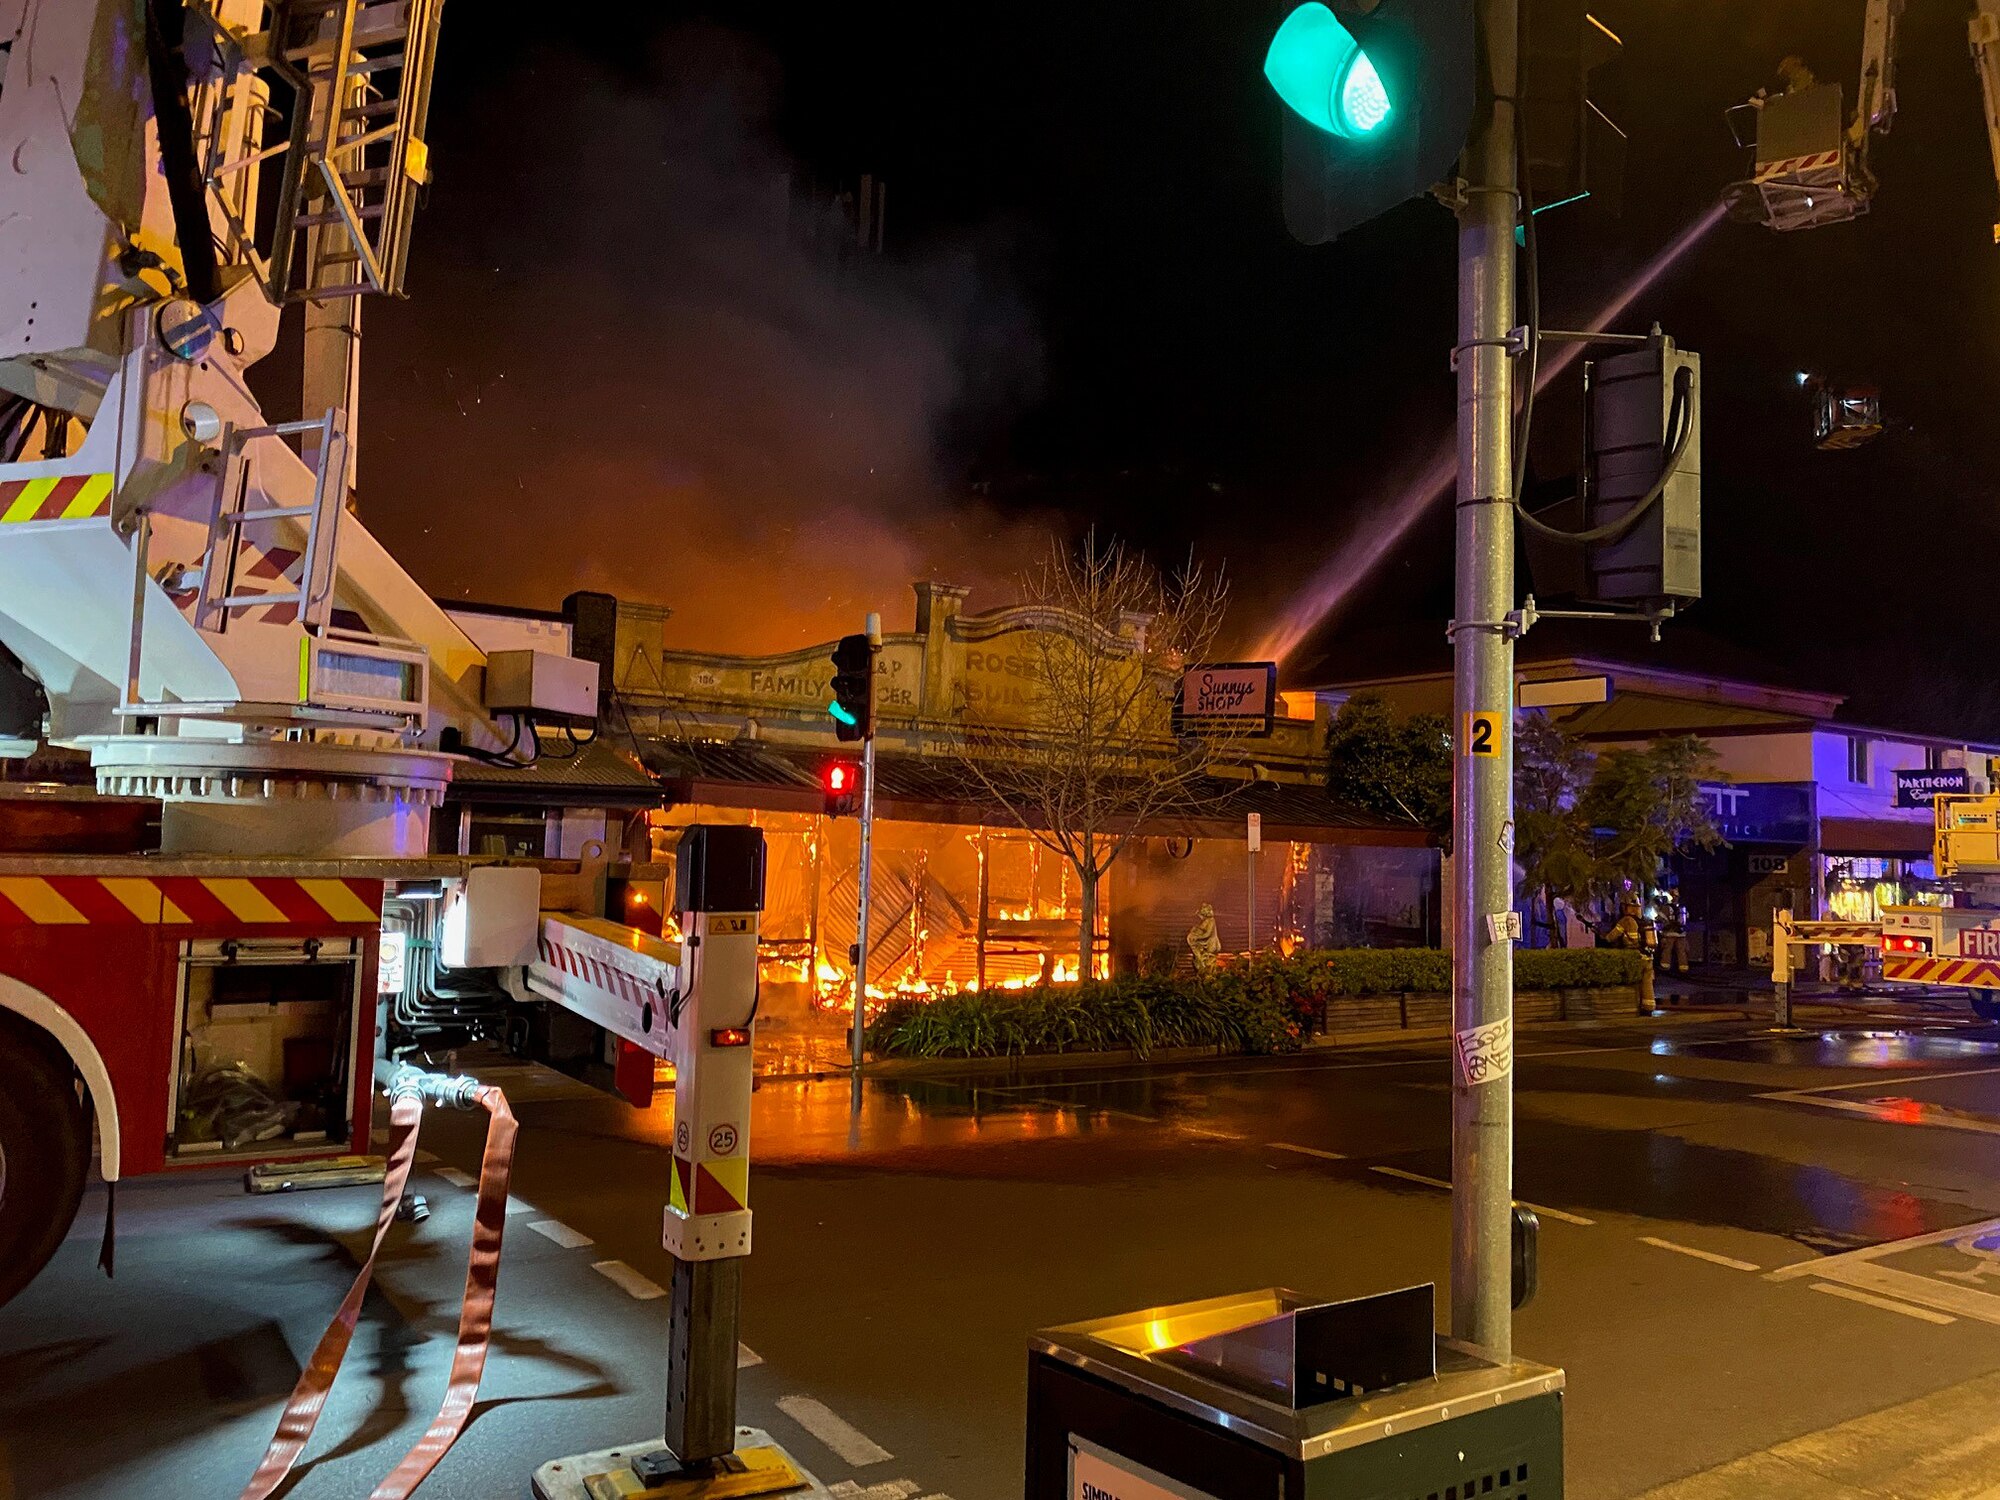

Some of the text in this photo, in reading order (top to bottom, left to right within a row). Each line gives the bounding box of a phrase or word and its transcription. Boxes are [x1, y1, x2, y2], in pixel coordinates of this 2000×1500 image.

[750, 671, 912, 705] FAMILY CER
[1198, 695, 1235, 711] SHOP
[1472, 718, 1492, 753] 2
[1898, 776, 1963, 789] PARTHENON
[1751, 857, 1785, 871] 108
[714, 1131, 733, 1148] 25
